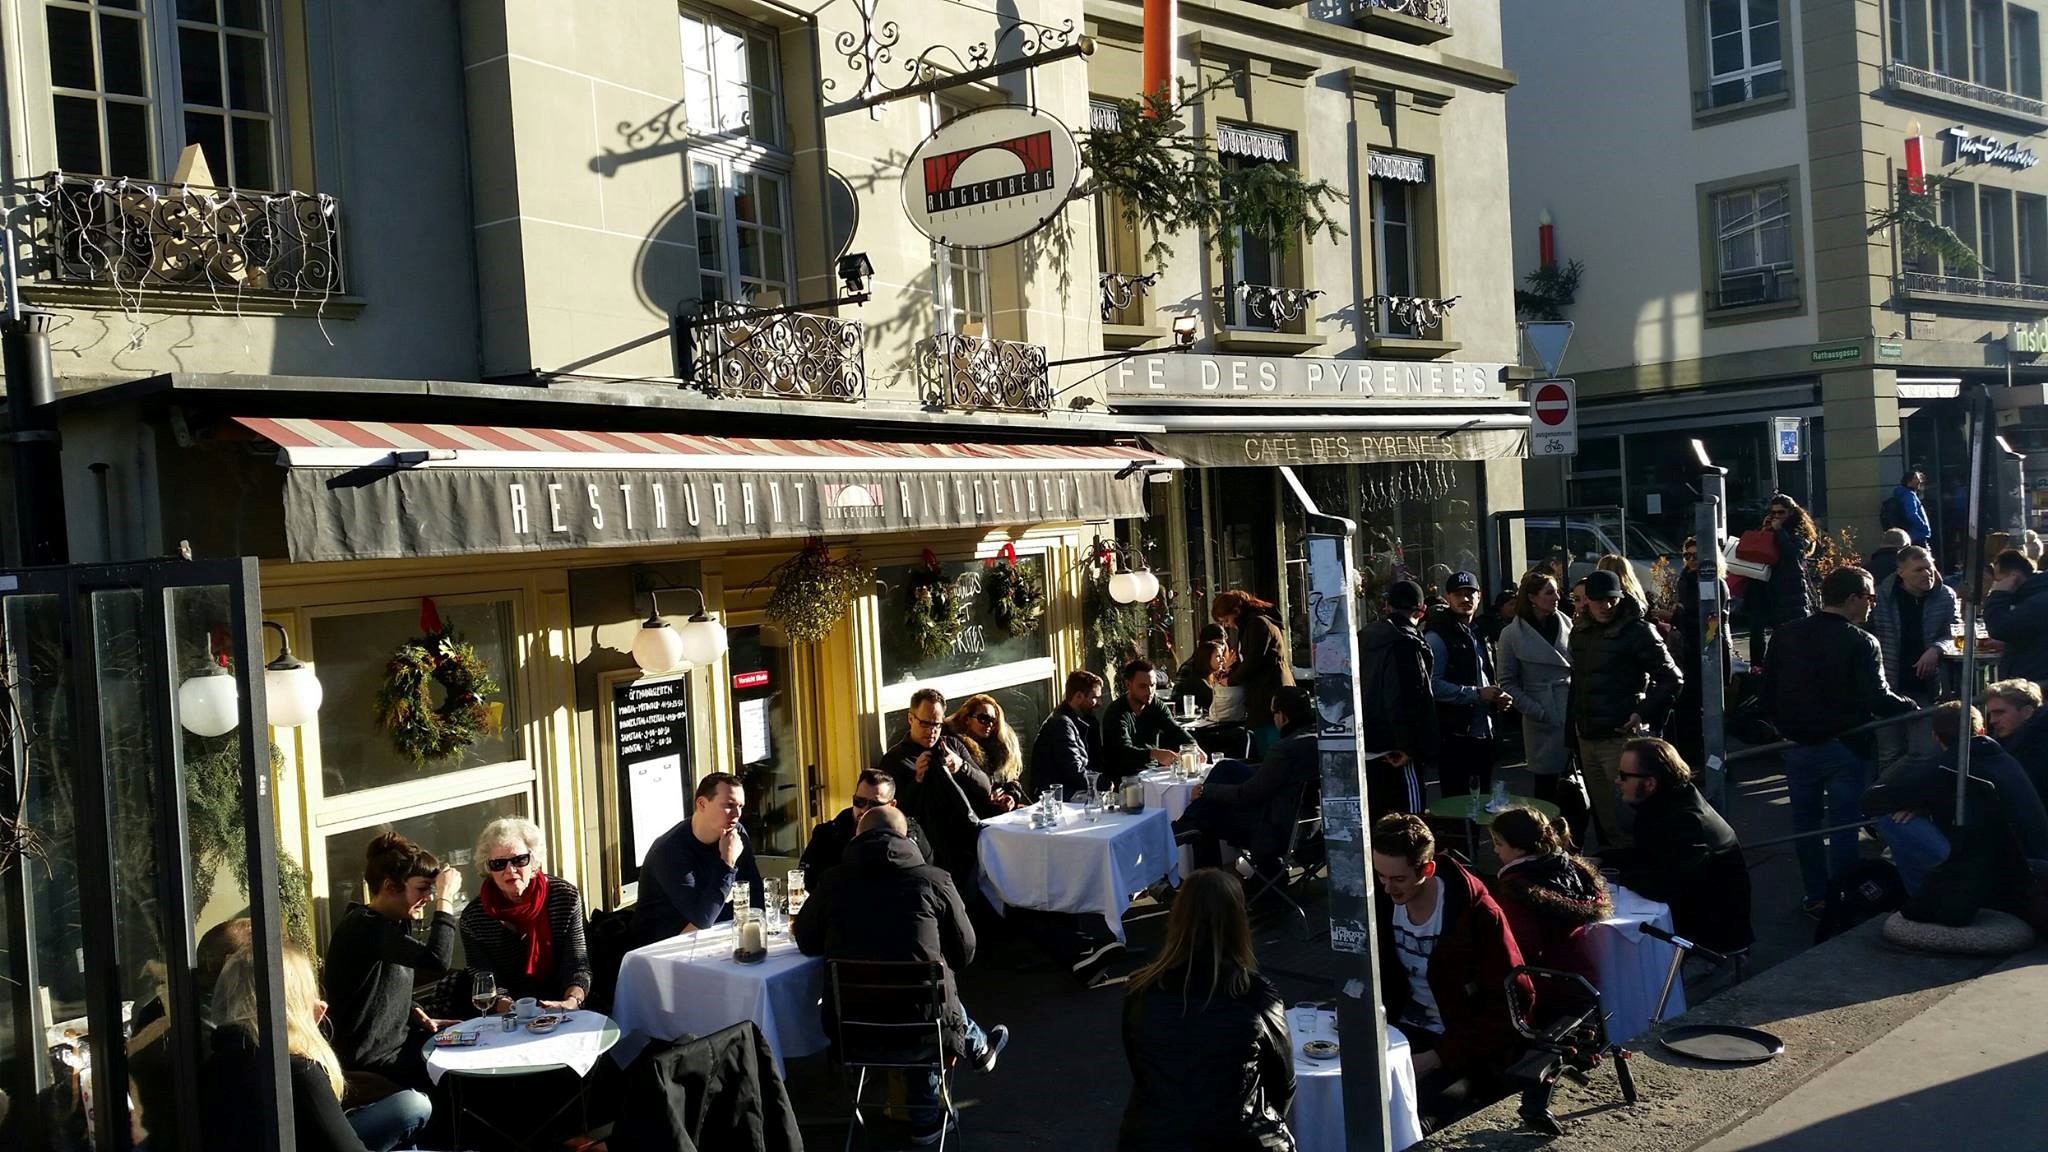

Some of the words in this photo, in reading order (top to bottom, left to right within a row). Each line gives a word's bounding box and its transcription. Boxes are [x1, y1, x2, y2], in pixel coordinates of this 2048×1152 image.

[927, 170, 1053, 212] RINGGENBERG
[1201, 359, 1277, 391] DES
[1308, 362, 1488, 394] PYRENEES
[1244, 438, 1298, 461] CAFE
[1310, 436, 1350, 459] DES
[509, 482, 804, 534] RESTAURANT
